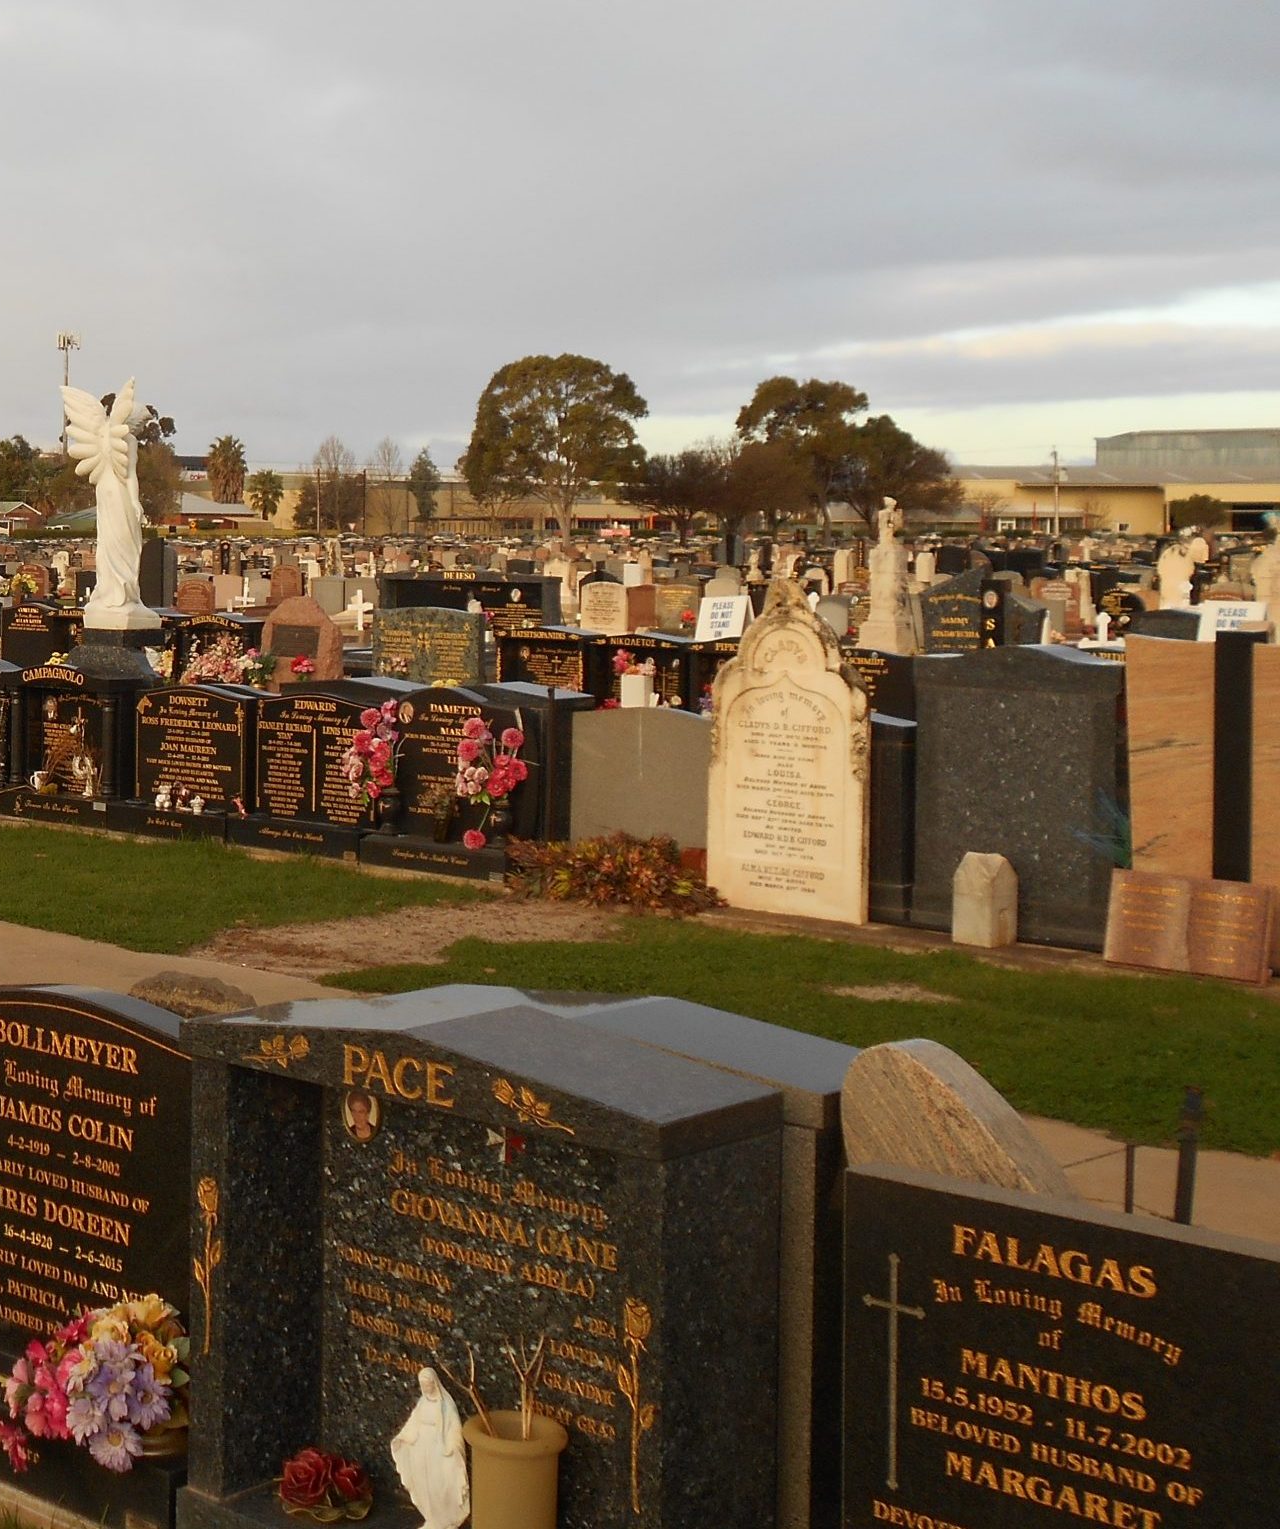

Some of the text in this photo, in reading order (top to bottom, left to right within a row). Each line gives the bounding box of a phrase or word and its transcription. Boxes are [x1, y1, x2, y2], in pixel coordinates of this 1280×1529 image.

[1218, 608, 1249, 617] PLEASE
[22, 666, 84, 686] CAMPAGNOLO
[169, 695, 209, 707] DOWSETT
[294, 700, 337, 713] EDWARDS
[430, 703, 482, 716] DAMETTO
[141, 716, 159, 725] ROSS
[160, 717, 200, 729] FREDERICK
[202, 721, 238, 733] LEONARD
[258, 721, 313, 734] STANLEY RICHARD
[160, 742, 217, 756] JOAN MAUREEN
[3, 1059, 59, 1099] Loving
[64, 1075, 132, 1117] Memory
[139, 1095, 157, 1118] of
[341, 1043, 456, 1108] PACE
[67, 1112, 135, 1152] COLIN
[7, 1134, 121, 1178] 4-2-1919 2-8-2002
[28, 1165, 68, 1191] LOVED
[71, 1176, 130, 1209] HUSBAND
[132, 1197, 150, 1215] OF
[388, 1149, 608, 1232] In Loving Memory
[43, 1198, 131, 1248] DOREEN
[388, 1189, 533, 1248] GIOVANNA
[3, 1223, 124, 1274] 16-4-1920 2-6-2015
[951, 1223, 1159, 1299] FALAGAS
[7, 1280, 71, 1316] PATRICIA,
[21, 1255, 61, 1281] LOVED
[63, 1270, 88, 1291] DAD
[91, 1280, 119, 1301] AND
[349, 1308, 401, 1339] PASSED
[403, 1326, 441, 1352] AWAY
[932, 1279, 1184, 1368] In Loving Memory
[1038, 1329, 1064, 1351] of
[960, 1347, 1148, 1422] MANTHOS
[920, 1377, 1193, 1472] 15.5.1952 11.7.2002
[910, 1406, 1205, 1507] BELOVED HUSBAND OF
[944, 1450, 1162, 1529] MARGARET
